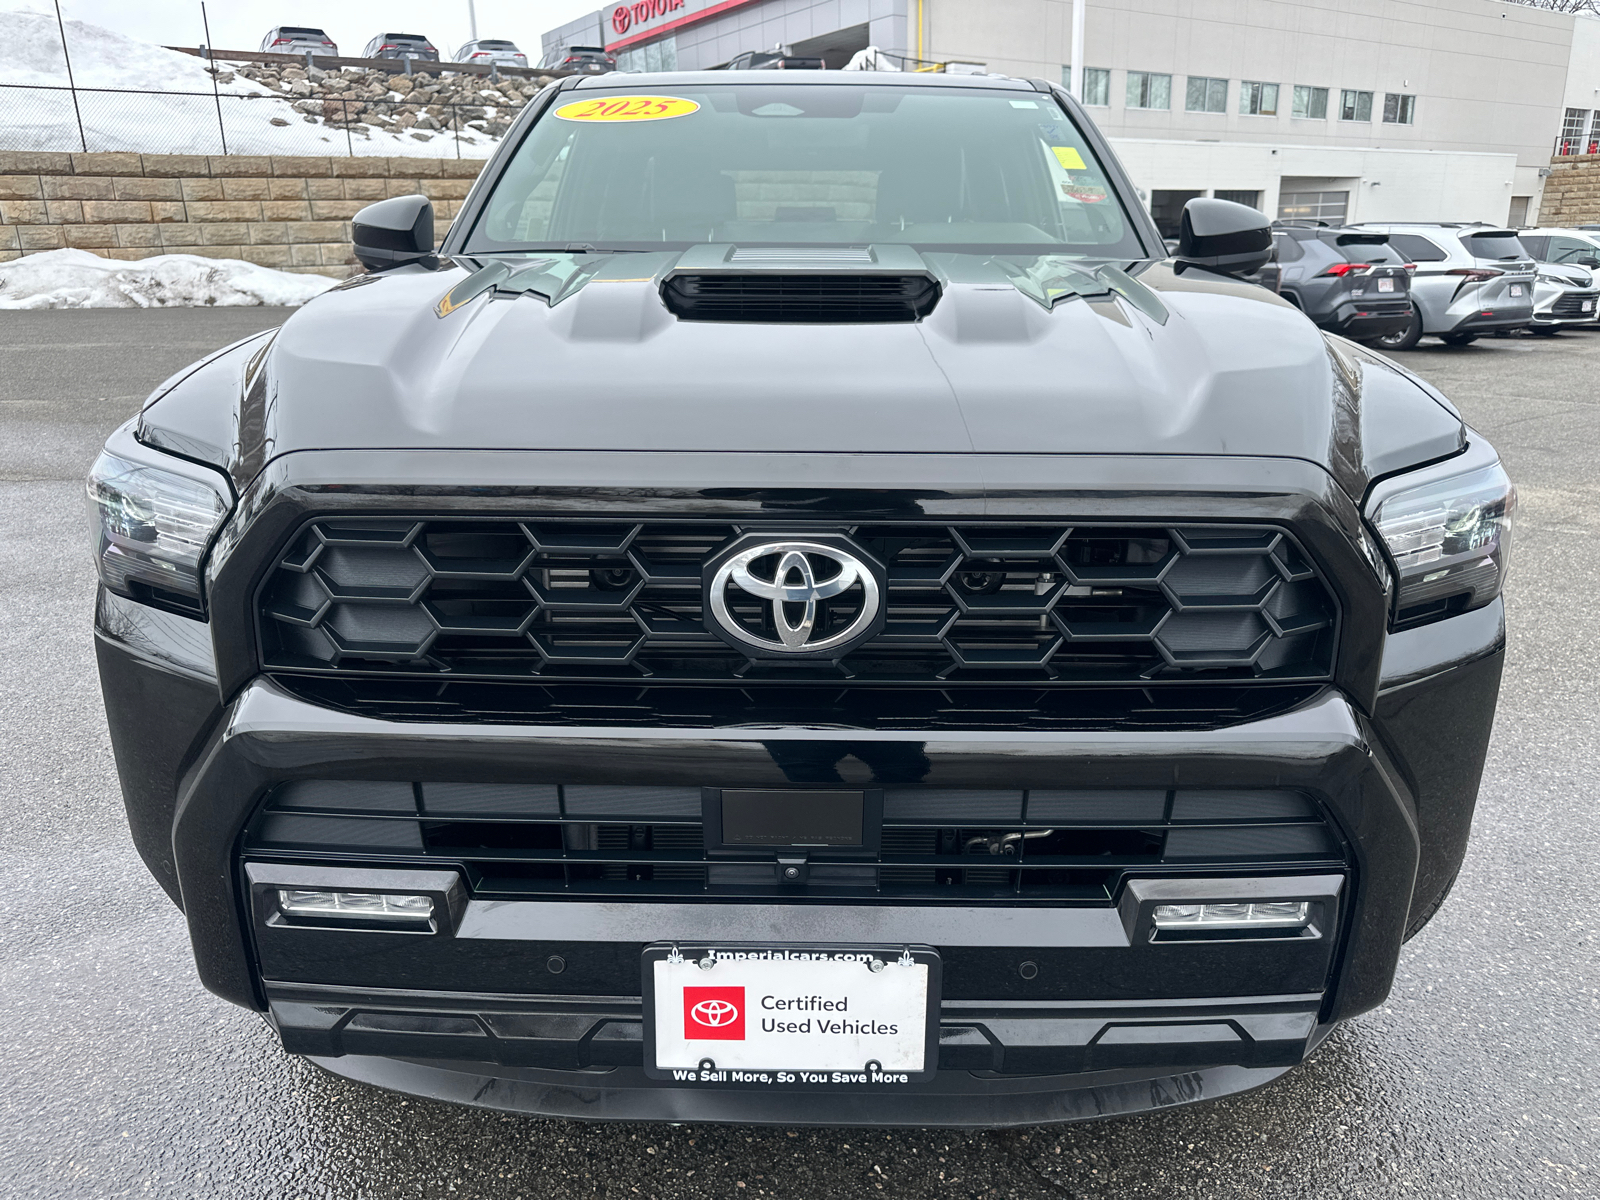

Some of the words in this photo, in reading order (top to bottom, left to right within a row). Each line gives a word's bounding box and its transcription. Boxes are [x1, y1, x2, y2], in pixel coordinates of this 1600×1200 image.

[574, 100, 678, 118] 2025
[708, 950, 874, 962] Imperialcars.com
[761, 995, 848, 1012] Certified
[762, 1018, 811, 1034] Used
[817, 1019, 898, 1035] Vehicles
[673, 1070, 697, 1082] We
[700, 1070, 727, 1082] Sell
[732, 1071, 773, 1085] More,
[777, 1072, 796, 1083] So
[800, 1072, 828, 1083] You
[832, 1072, 867, 1084] Save
[872, 1072, 908, 1083] More
